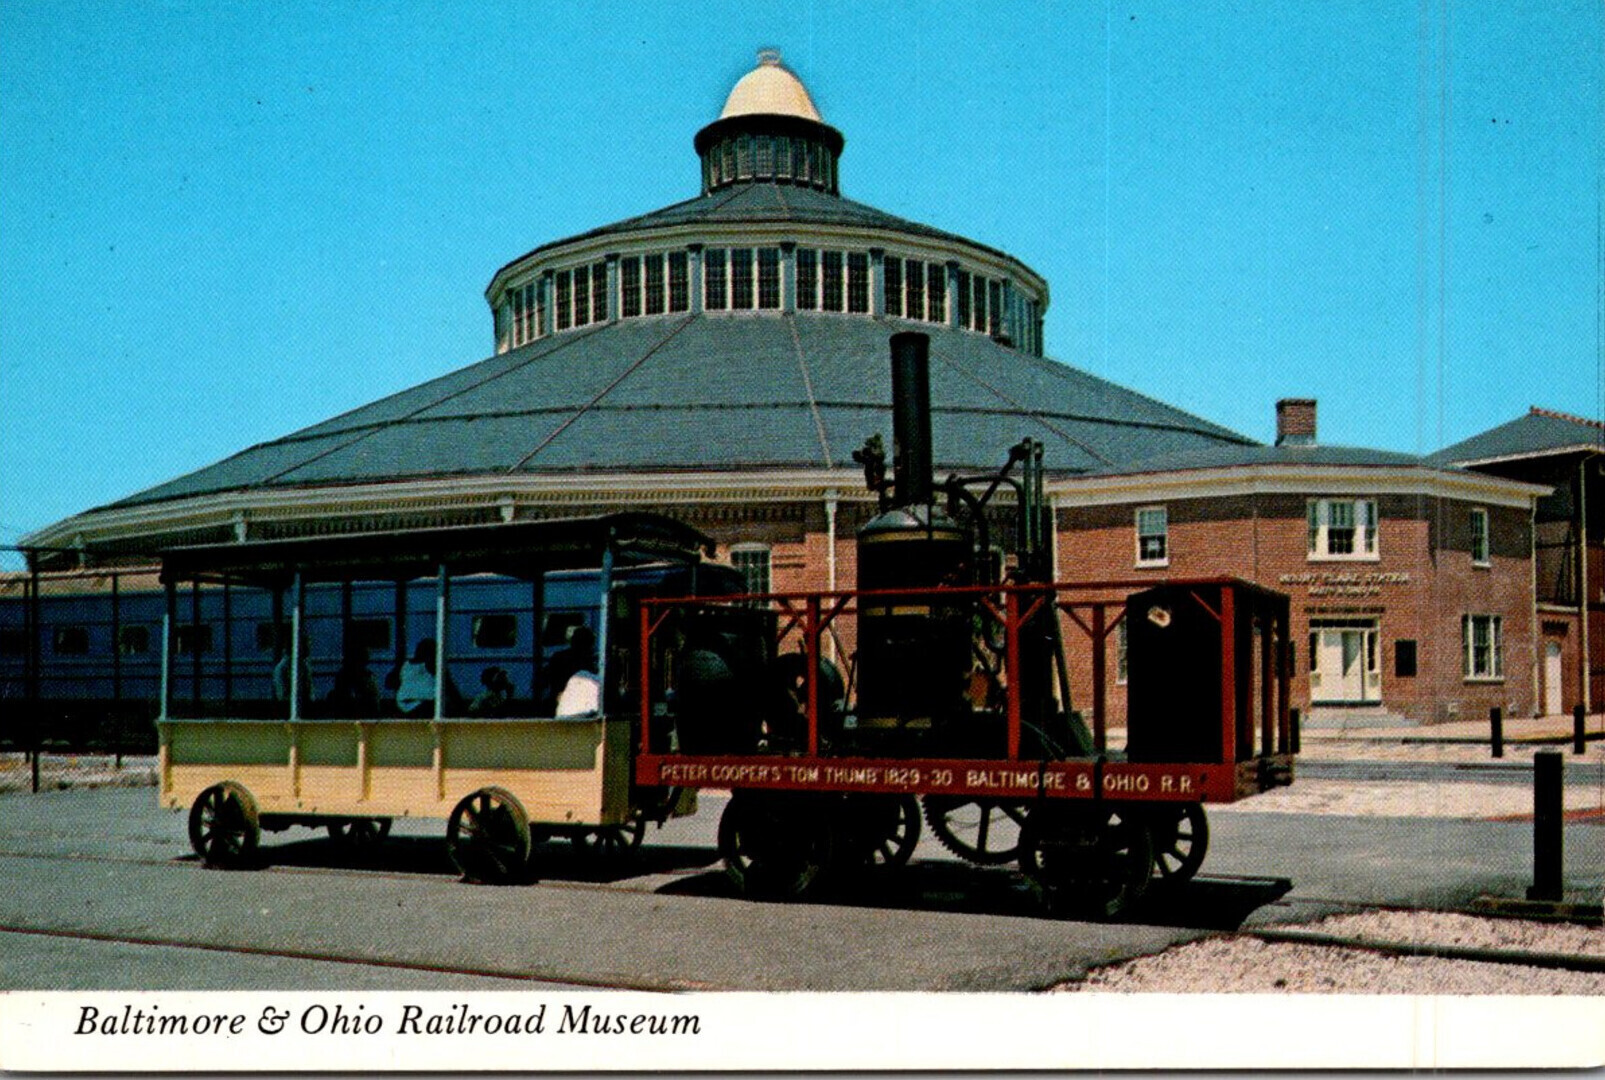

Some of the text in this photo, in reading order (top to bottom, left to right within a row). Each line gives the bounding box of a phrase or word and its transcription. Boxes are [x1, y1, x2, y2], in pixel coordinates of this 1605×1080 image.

[660, 763, 707, 782] PETER
[966, 769, 1066, 790] BALTIMORE
[1075, 772, 1091, 791] &
[1102, 773, 1150, 792] OHIO
